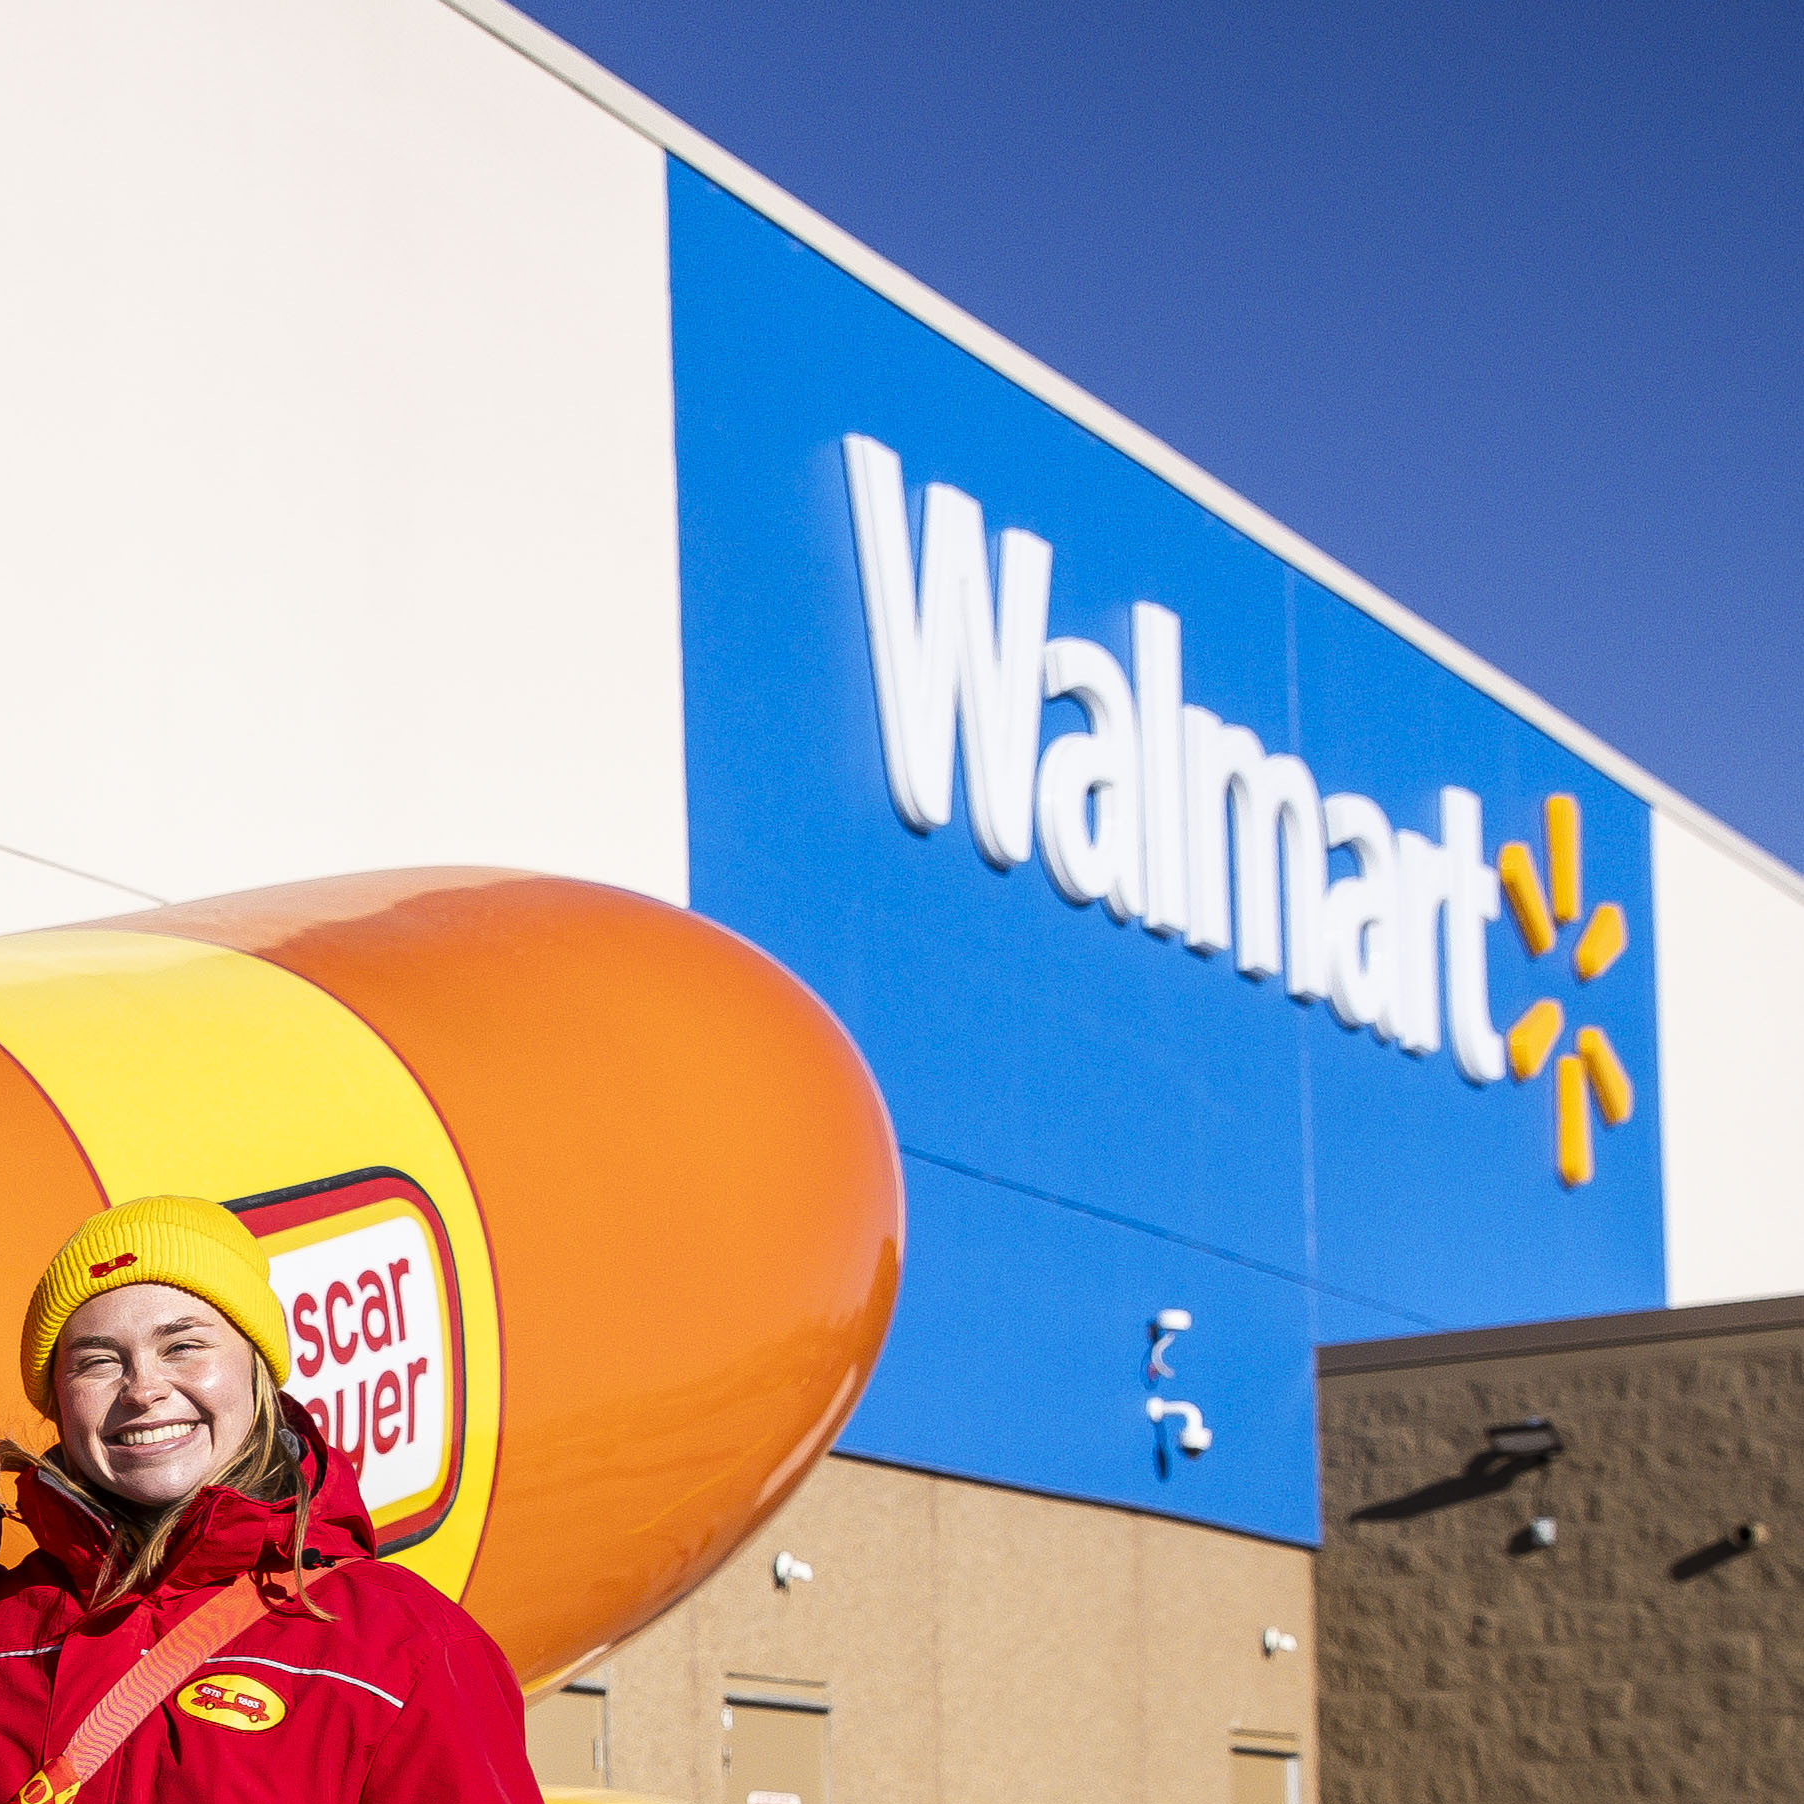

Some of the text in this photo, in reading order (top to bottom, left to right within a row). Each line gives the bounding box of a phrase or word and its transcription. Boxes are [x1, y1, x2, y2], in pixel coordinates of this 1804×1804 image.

[842, 432, 1506, 1085] Walmart
[293, 1257, 410, 1378] scar
[304, 1357, 428, 1482] ayer
[237, 1696, 260, 1709] 1883
